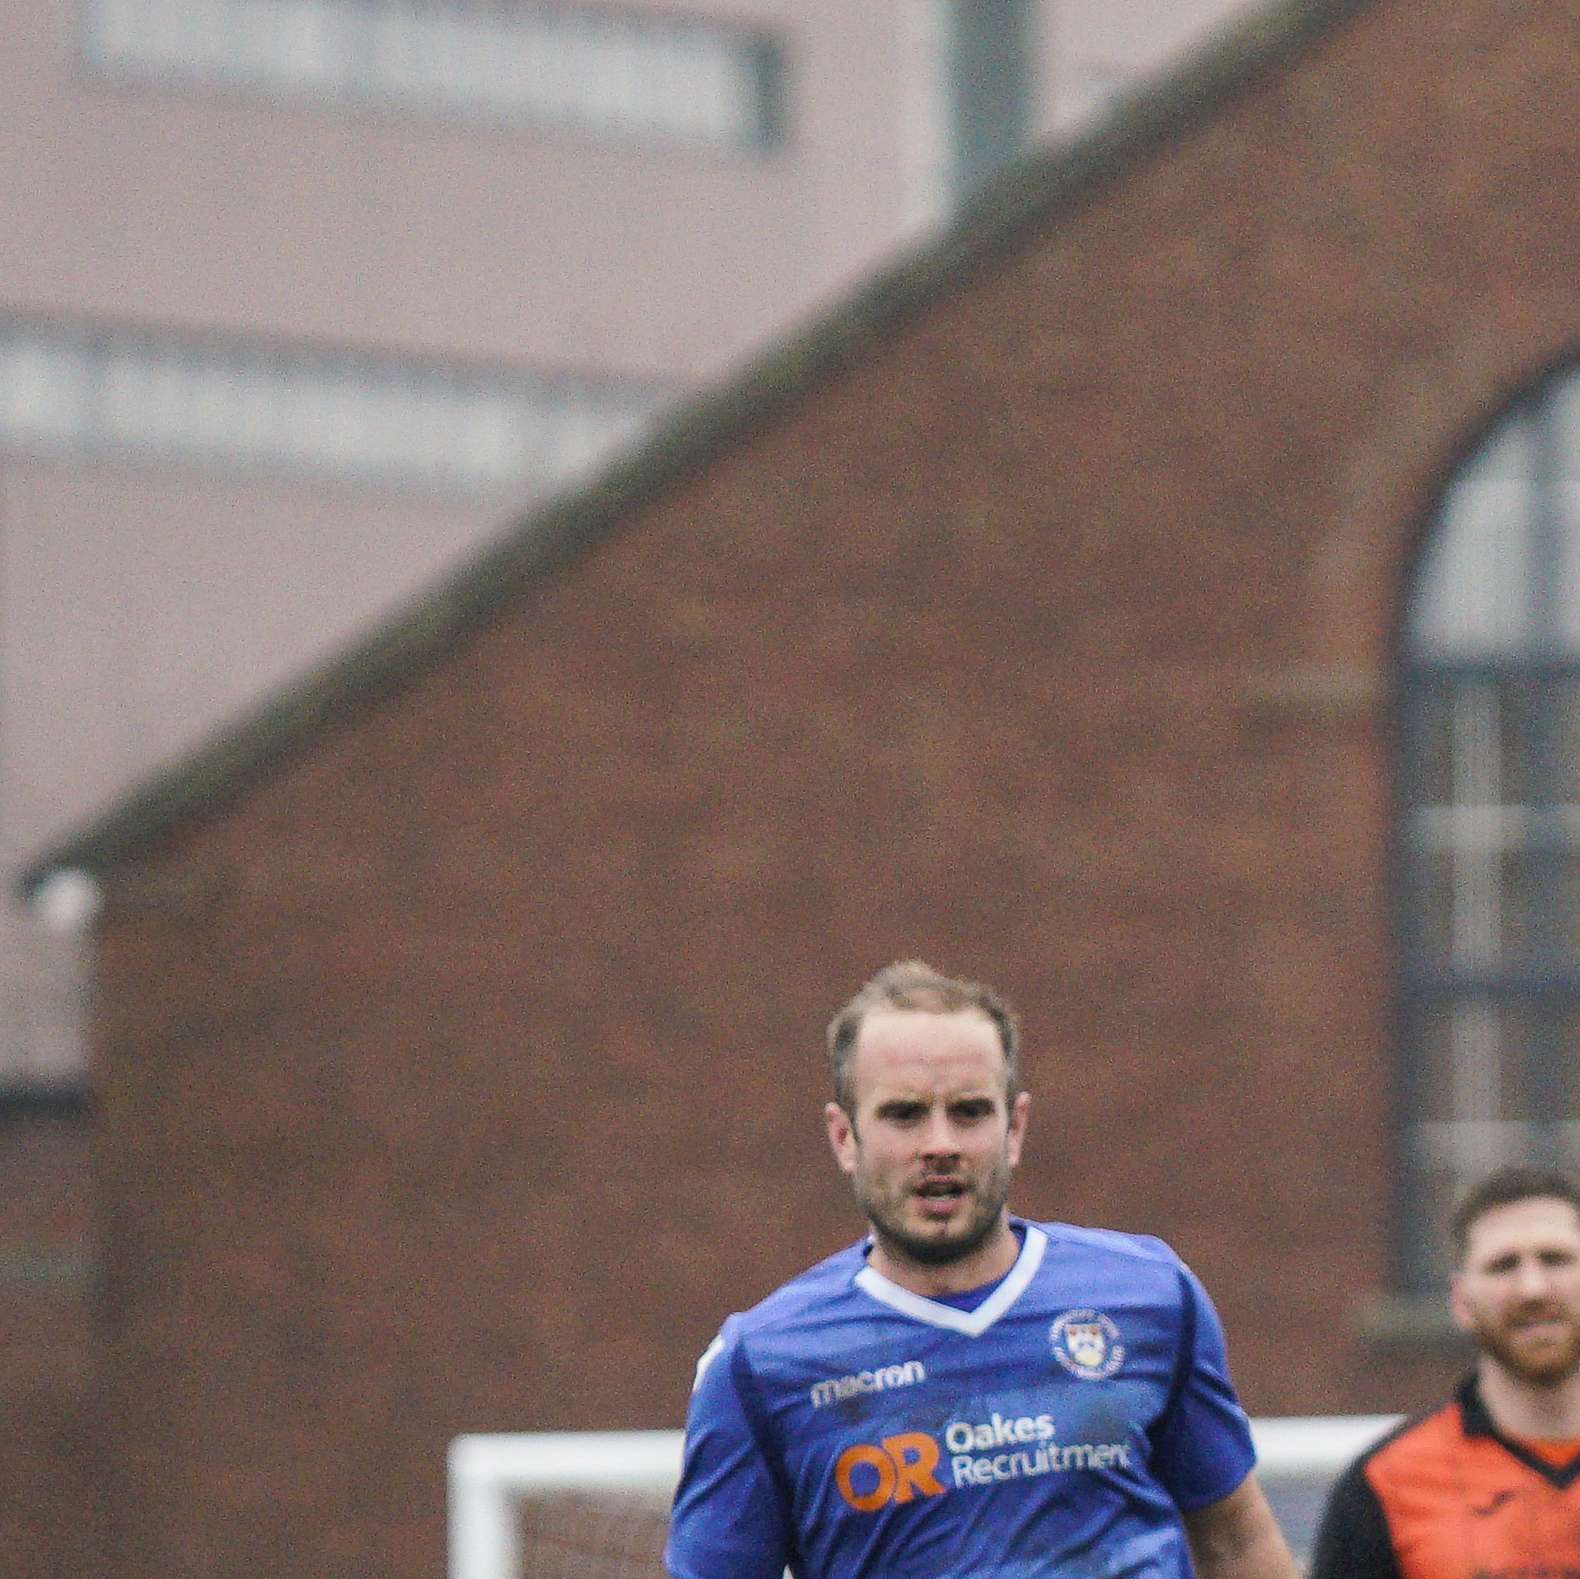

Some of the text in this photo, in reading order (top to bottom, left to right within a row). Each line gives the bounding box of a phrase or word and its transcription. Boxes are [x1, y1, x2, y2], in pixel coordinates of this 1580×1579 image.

[811, 1359, 926, 1408] macron
[945, 1412, 1055, 1453] Oakes
[835, 1431, 946, 1512] OR
[951, 1440, 1131, 1488] Recruitmen
